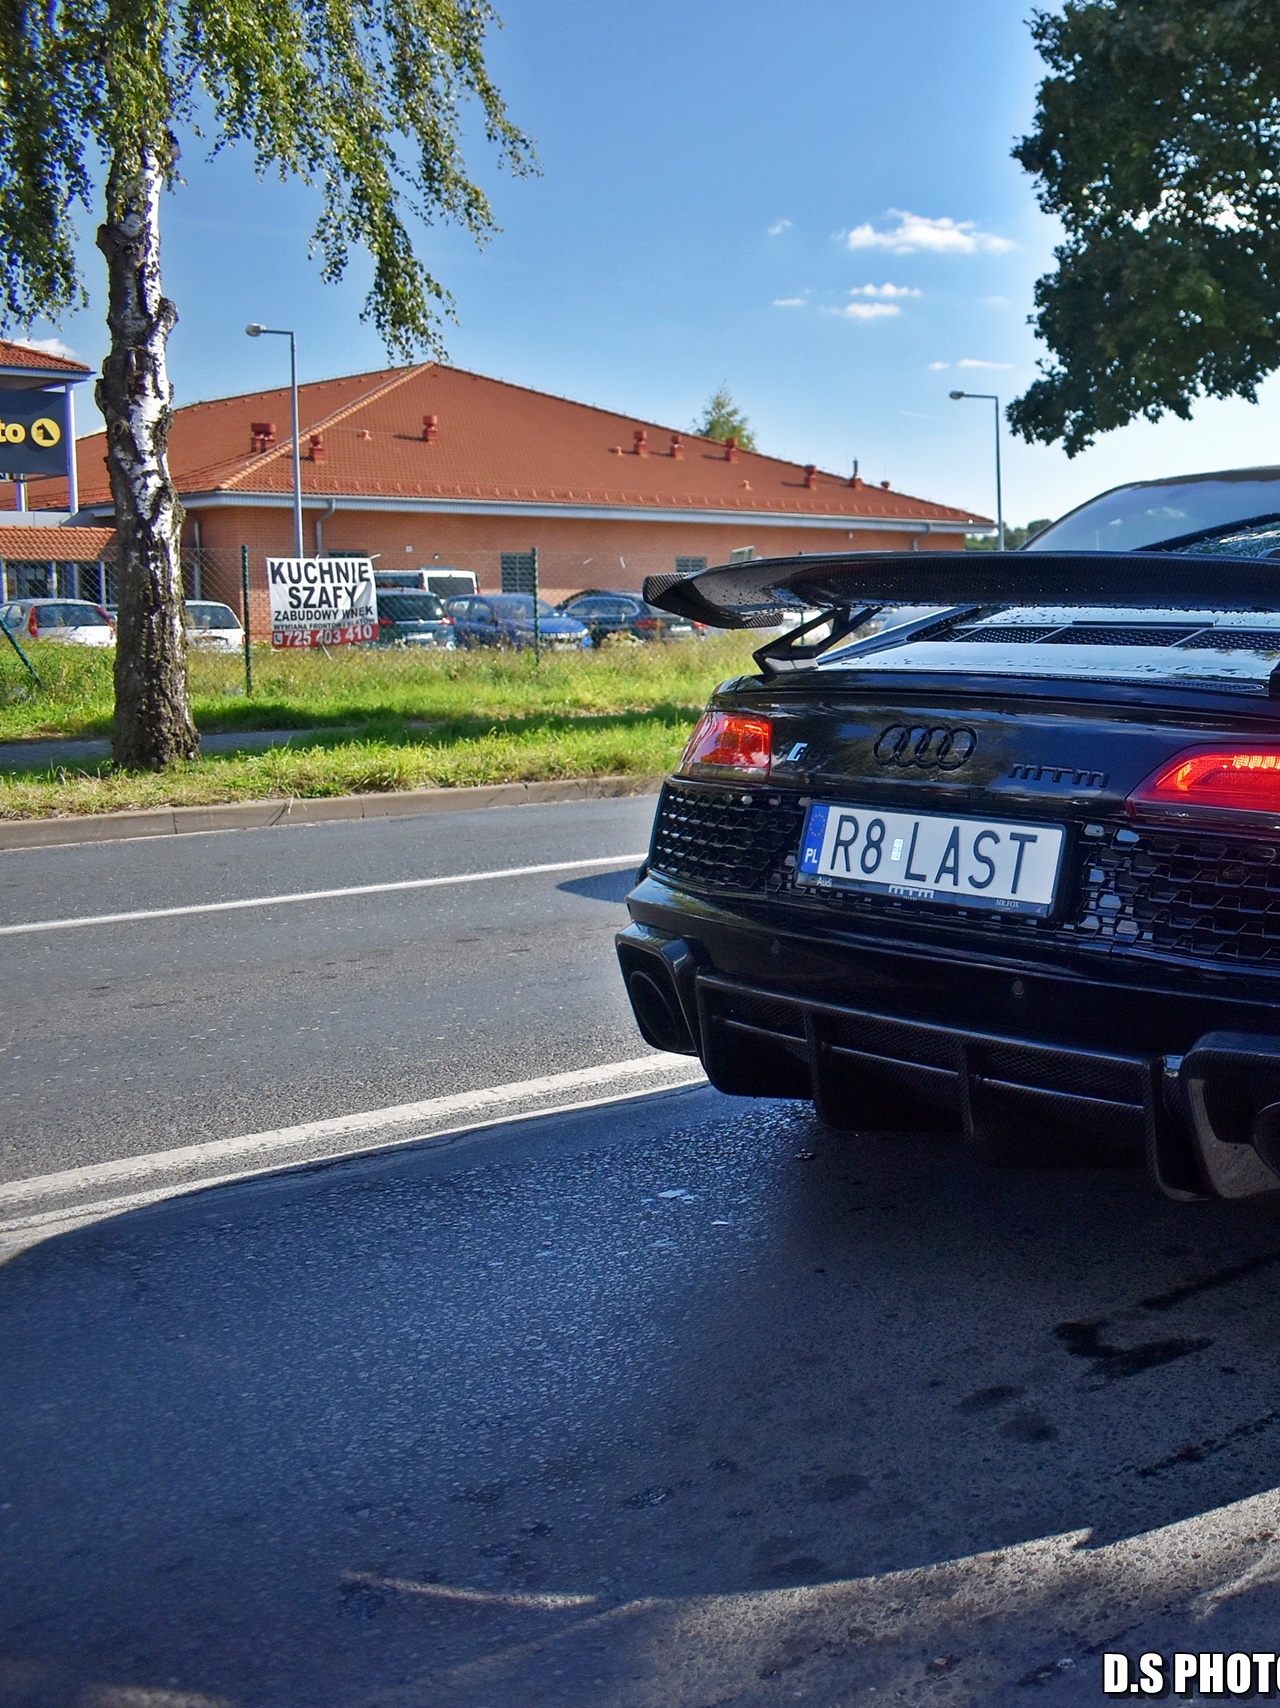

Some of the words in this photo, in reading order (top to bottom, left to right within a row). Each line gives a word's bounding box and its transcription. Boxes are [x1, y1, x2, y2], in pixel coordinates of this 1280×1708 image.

[270, 561, 371, 584] KUCHNIE
[288, 585, 358, 609] SZAFY
[274, 609, 339, 621] ZABUDOWY
[284, 630, 311, 646] 725
[316, 629, 342, 644] 403
[345, 624, 373, 641] 410
[804, 847, 818, 864] PL
[830, 814, 886, 874] R8
[904, 821, 1038, 894] LAST
